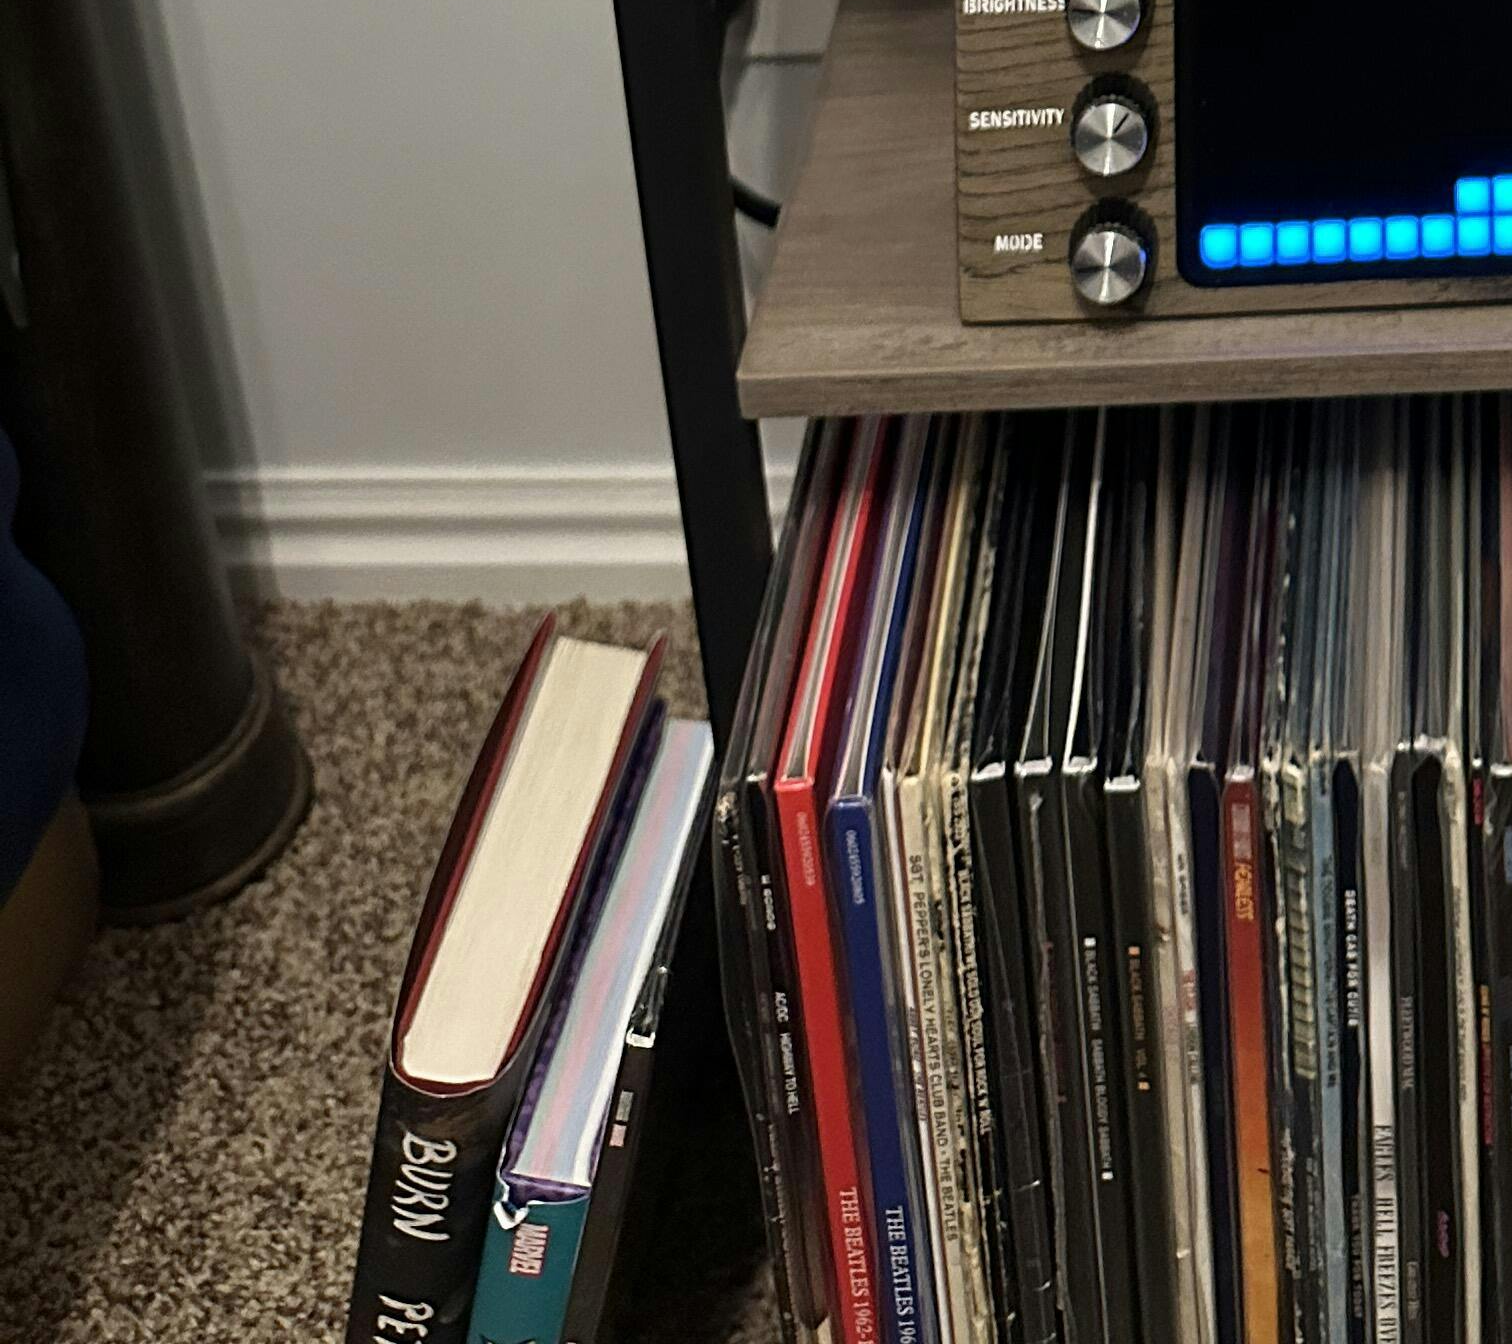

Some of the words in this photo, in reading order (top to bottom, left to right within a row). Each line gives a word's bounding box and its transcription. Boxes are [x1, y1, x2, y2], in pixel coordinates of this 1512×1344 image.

[968, 108, 1065, 130] SENSITIVITY
[994, 233, 1043, 252] MODE
[914, 892, 931, 958] PEPPER'S
[1345, 889, 1356, 930] DEATH
[1346, 934, 1357, 959] CAB
[1085, 950, 1098, 983] BLACK
[1346, 963, 1358, 987] FOR
[919, 962, 935, 1013] LONELY
[1087, 985, 1102, 1030] SABBATH
[1347, 991, 1359, 1026] CUTIE
[926, 1018, 941, 1070] HEARTS
[785, 1077, 797, 1090] TO
[787, 1091, 800, 1115] HELL
[930, 1075, 945, 1107] CLUB
[934, 1112, 949, 1146] BAND
[940, 1158, 952, 1182] THE
[1375, 1125, 1394, 1181] EAGLES
[391, 1132, 457, 1241] BURN
[839, 1187, 861, 1224] THE
[885, 1205, 907, 1242] THE
[943, 1186, 958, 1242] BEATLES
[1376, 1198, 1395, 1237] HELL
[510, 1224, 548, 1276] MARVEL
[843, 1227, 870, 1297] BEATLES
[889, 1245, 915, 1316] BEATLES
[1378, 1246, 1396, 1309] FREEZES
[372, 1295, 434, 1344] PE
